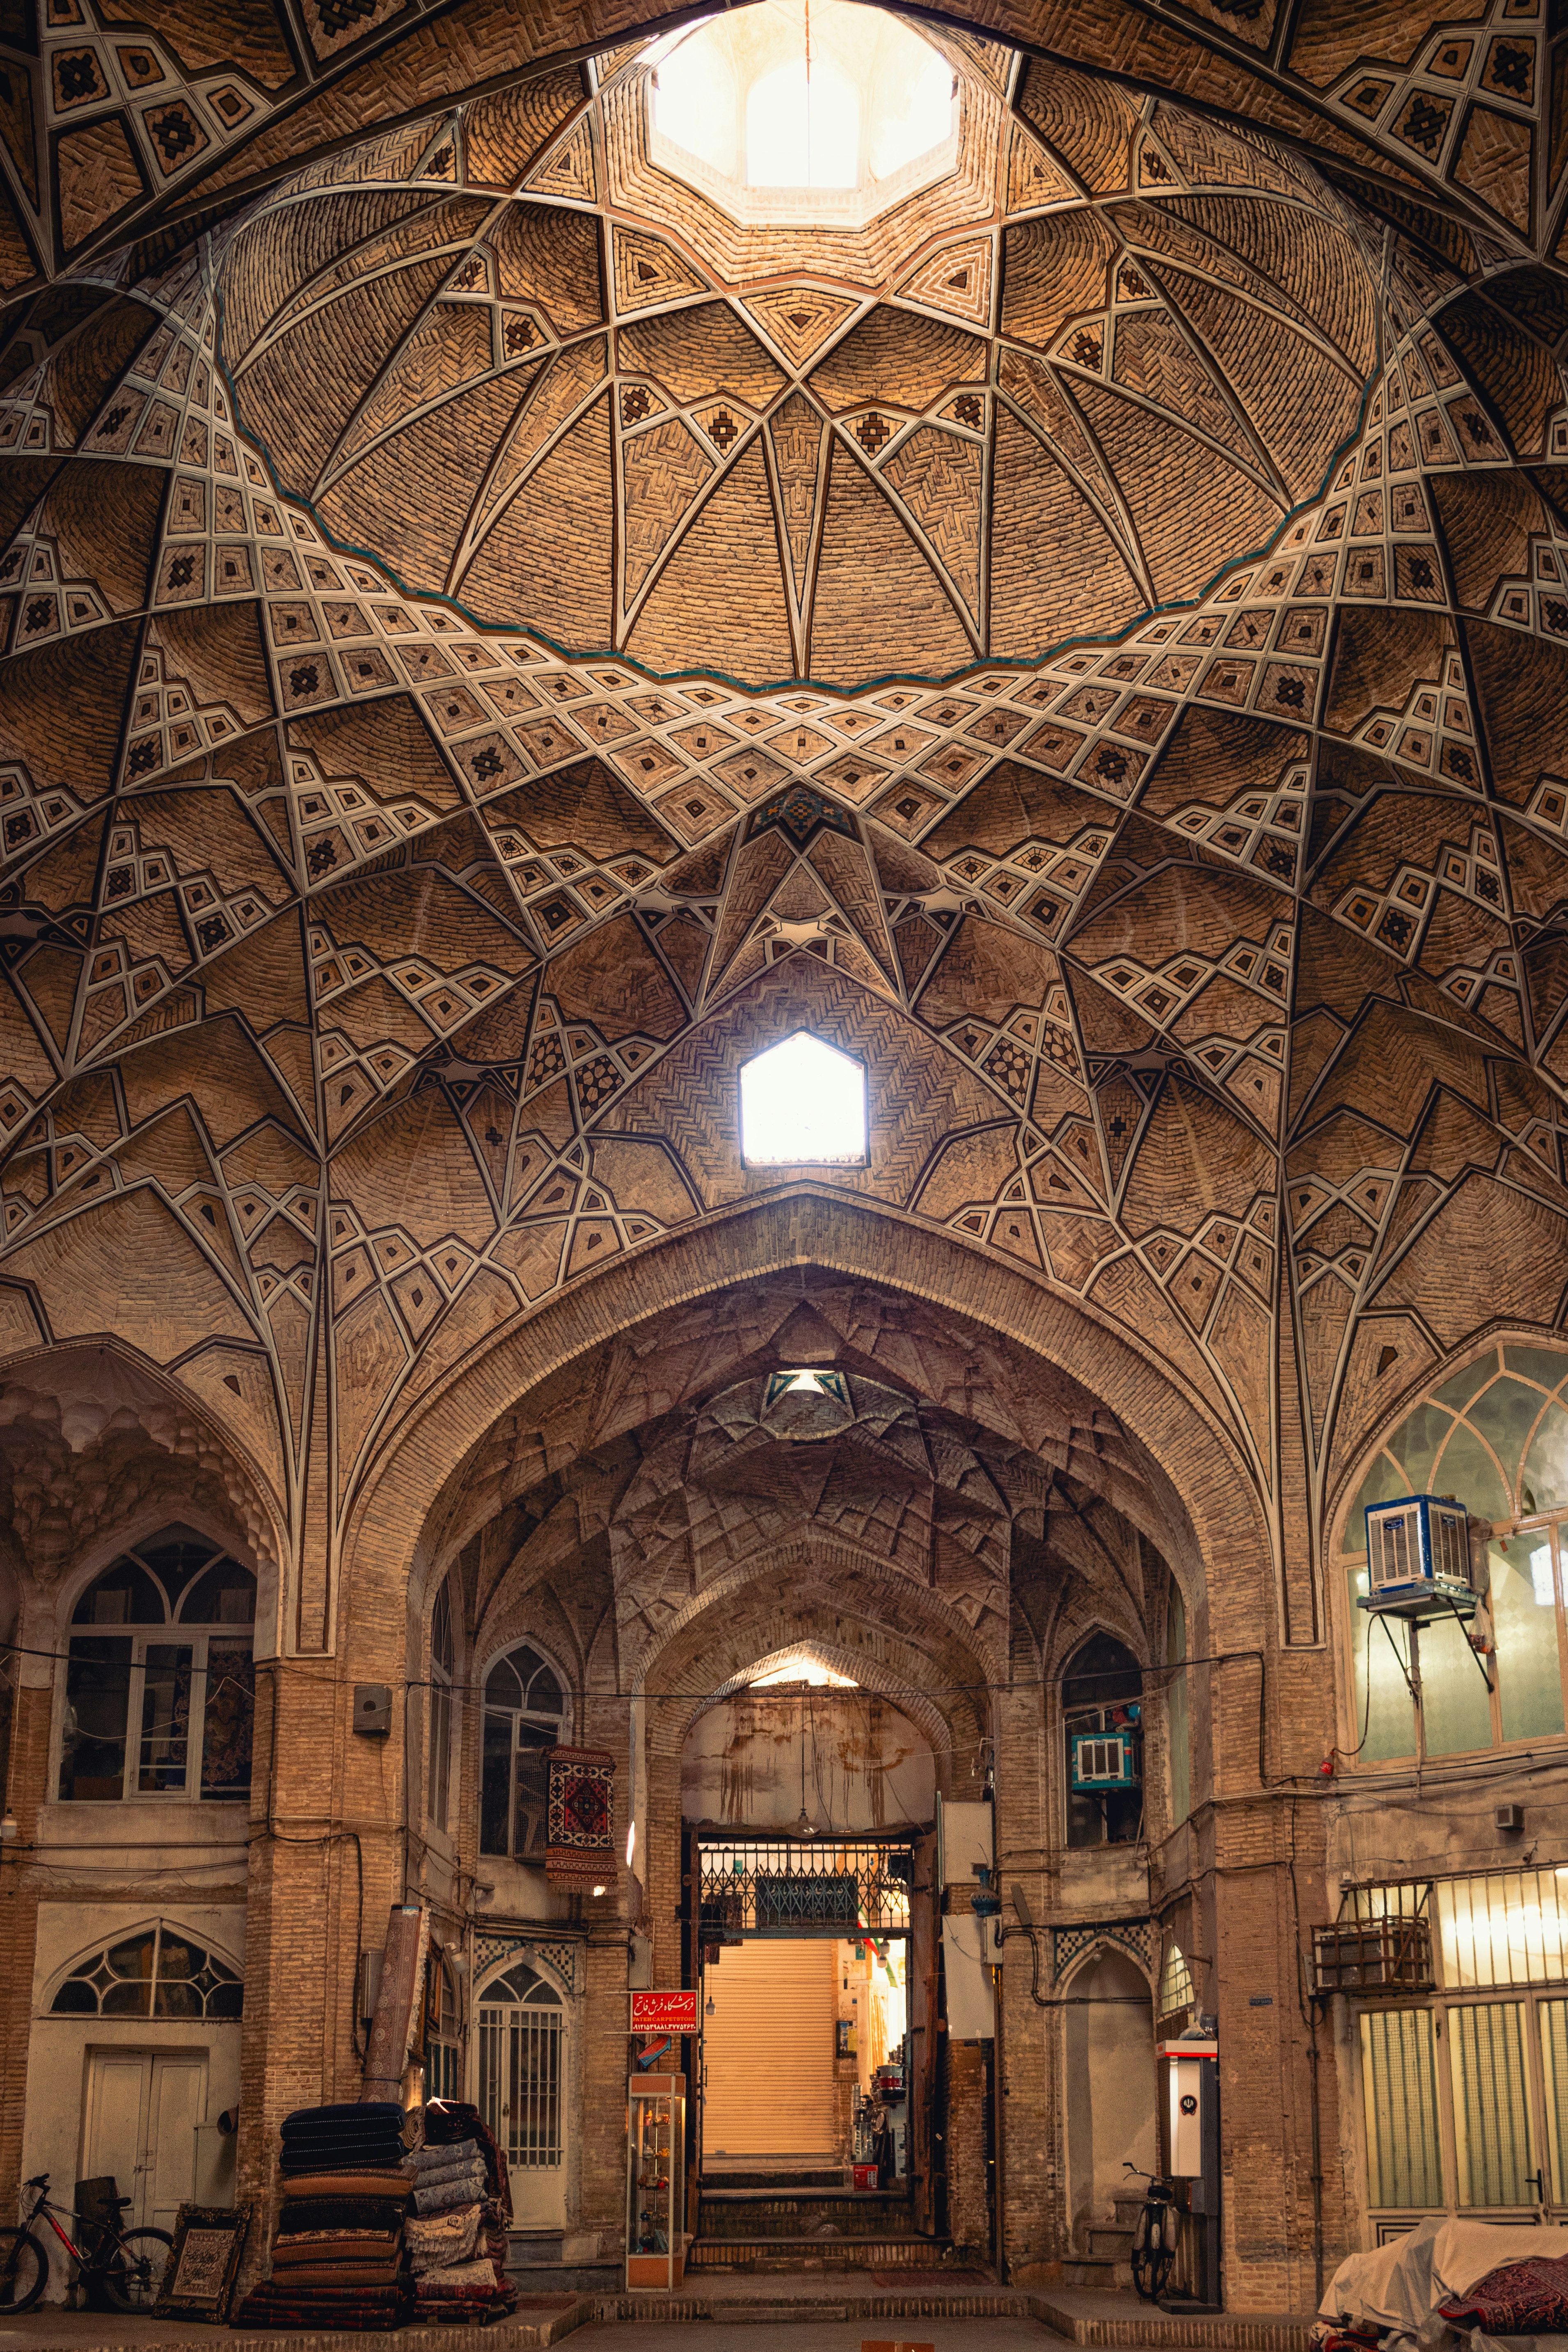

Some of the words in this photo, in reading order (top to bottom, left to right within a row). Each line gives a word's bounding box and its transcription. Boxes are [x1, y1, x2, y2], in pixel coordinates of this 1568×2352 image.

[634, 1996, 648, 2016] فاتح
[648, 1998, 664, 2015] فرش
[664, 1995, 694, 2011] فروشگاه
